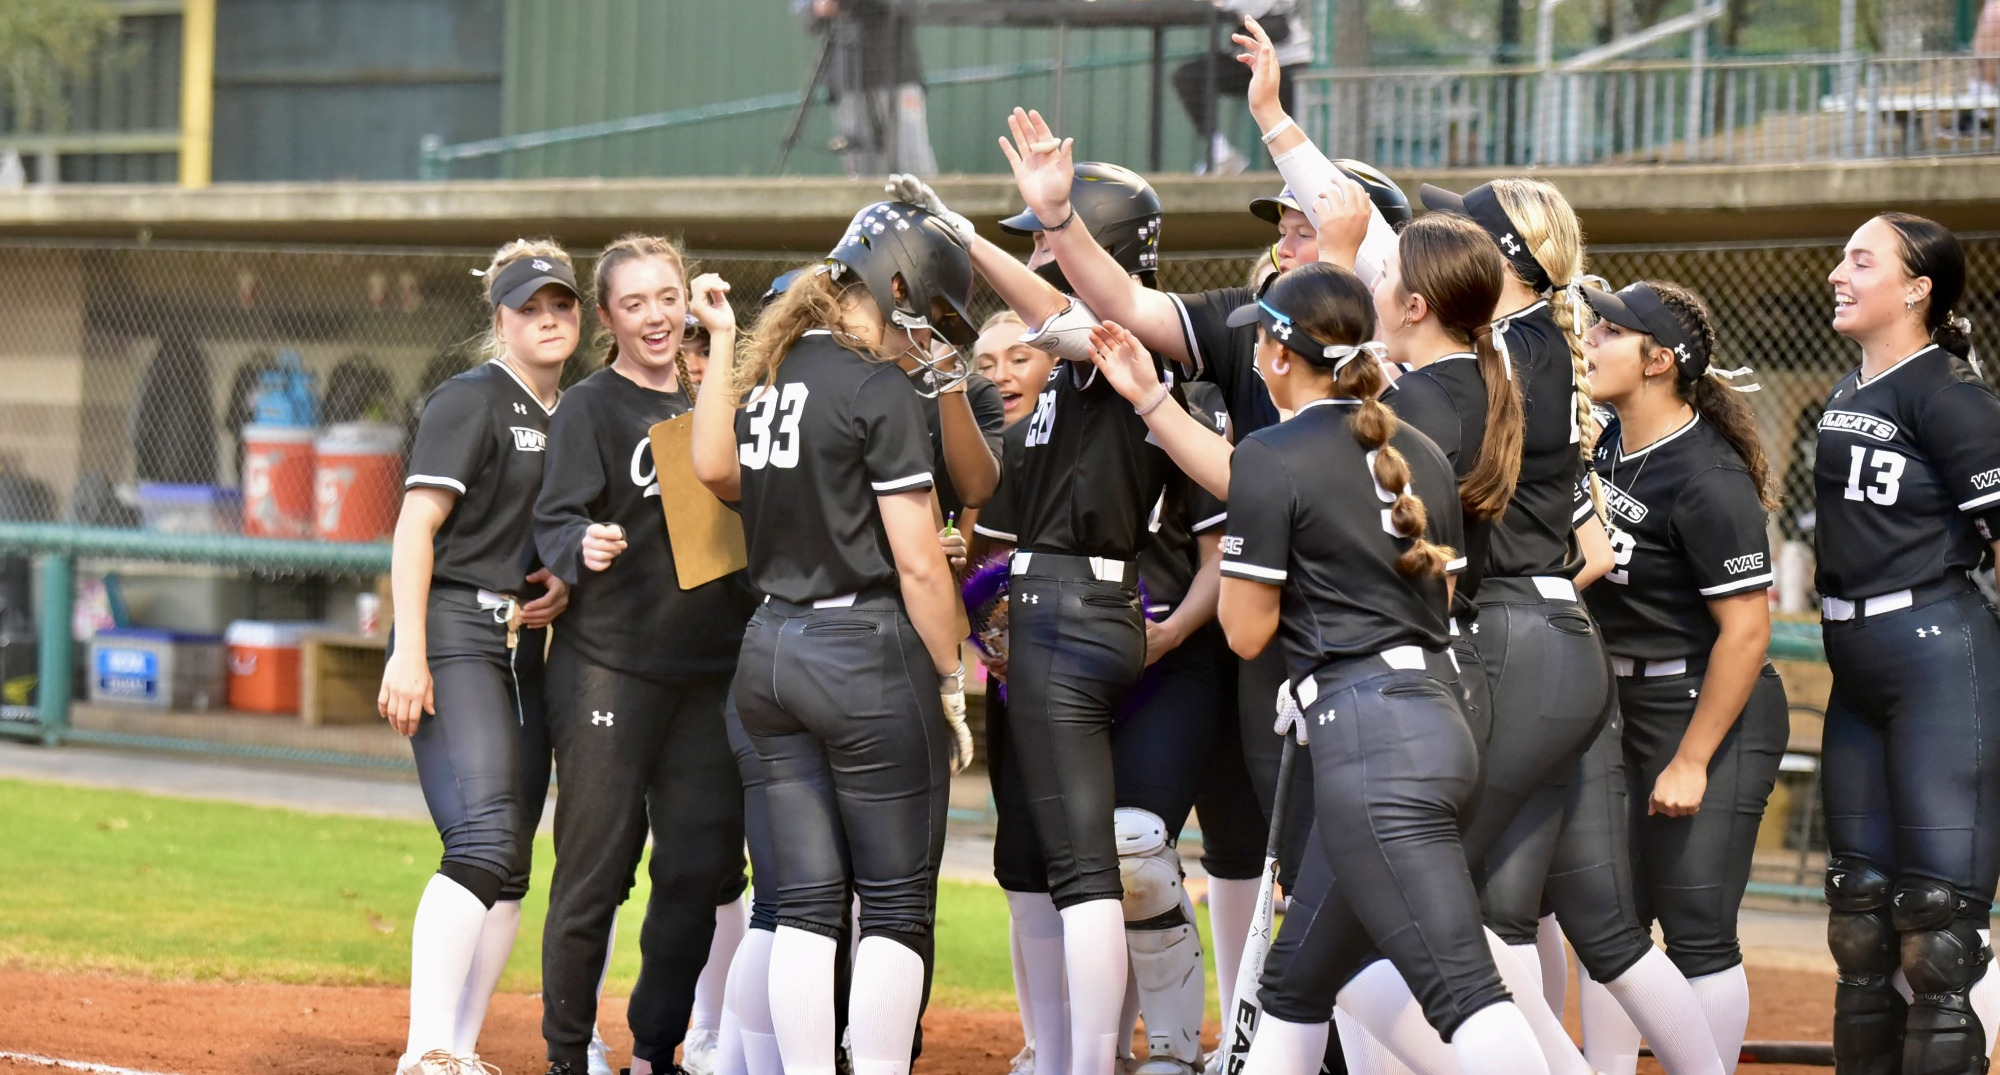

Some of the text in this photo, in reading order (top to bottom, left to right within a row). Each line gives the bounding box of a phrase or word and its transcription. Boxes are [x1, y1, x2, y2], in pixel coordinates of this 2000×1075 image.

[739, 382, 810, 470] 33
[1819, 411, 1895, 440] ILDCATS
[1843, 444, 1907, 507] 13
[1723, 552, 1764, 575] WAC
